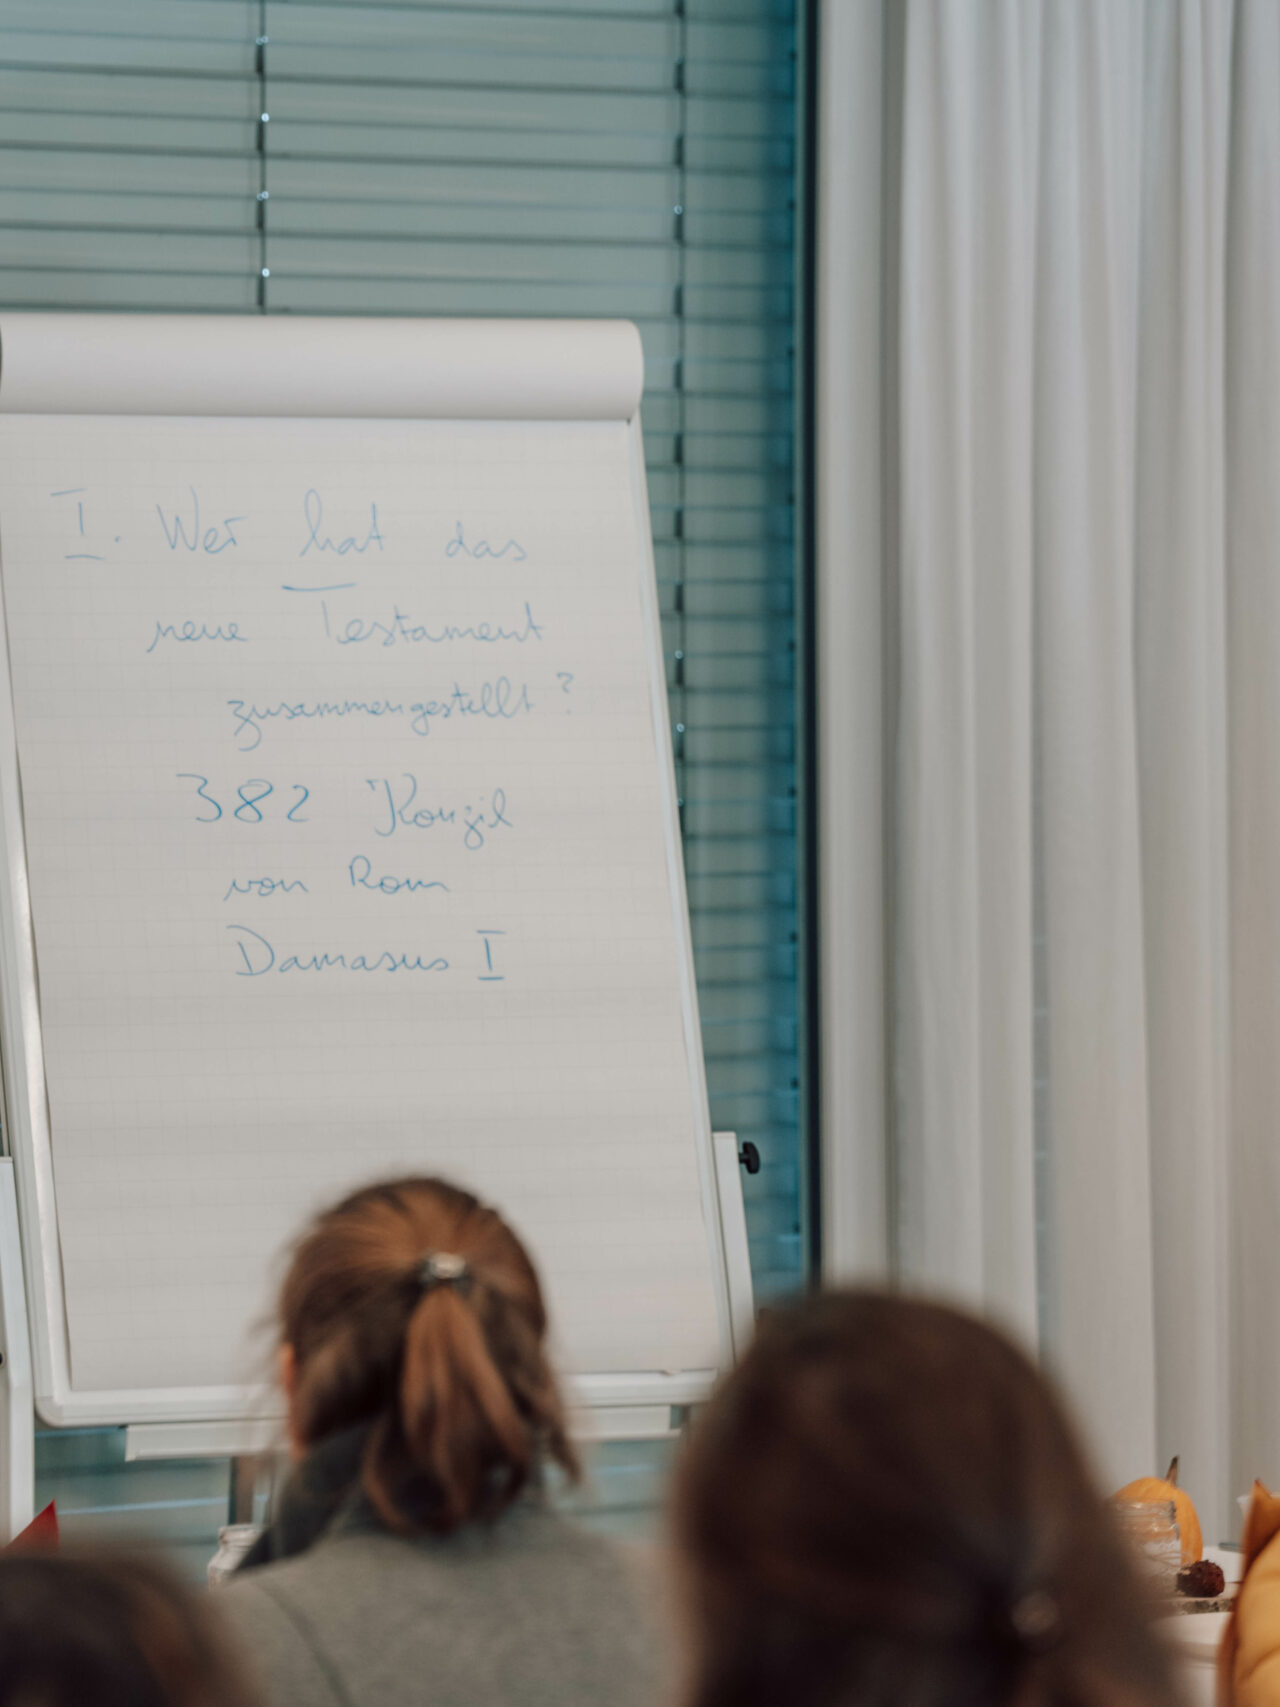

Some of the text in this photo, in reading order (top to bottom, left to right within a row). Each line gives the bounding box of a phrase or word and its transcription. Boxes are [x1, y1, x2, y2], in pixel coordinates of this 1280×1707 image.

[156, 484, 248, 555] Wer
[298, 489, 384, 557] hat
[444, 520, 528, 562] das
[145, 582, 544, 654] neue Testament
[226, 675, 535, 752] zusammengestellt
[175, 773, 515, 850] 382 Konzil
[223, 854, 451, 901] von Rom
[226, 924, 508, 981] Damasus I
